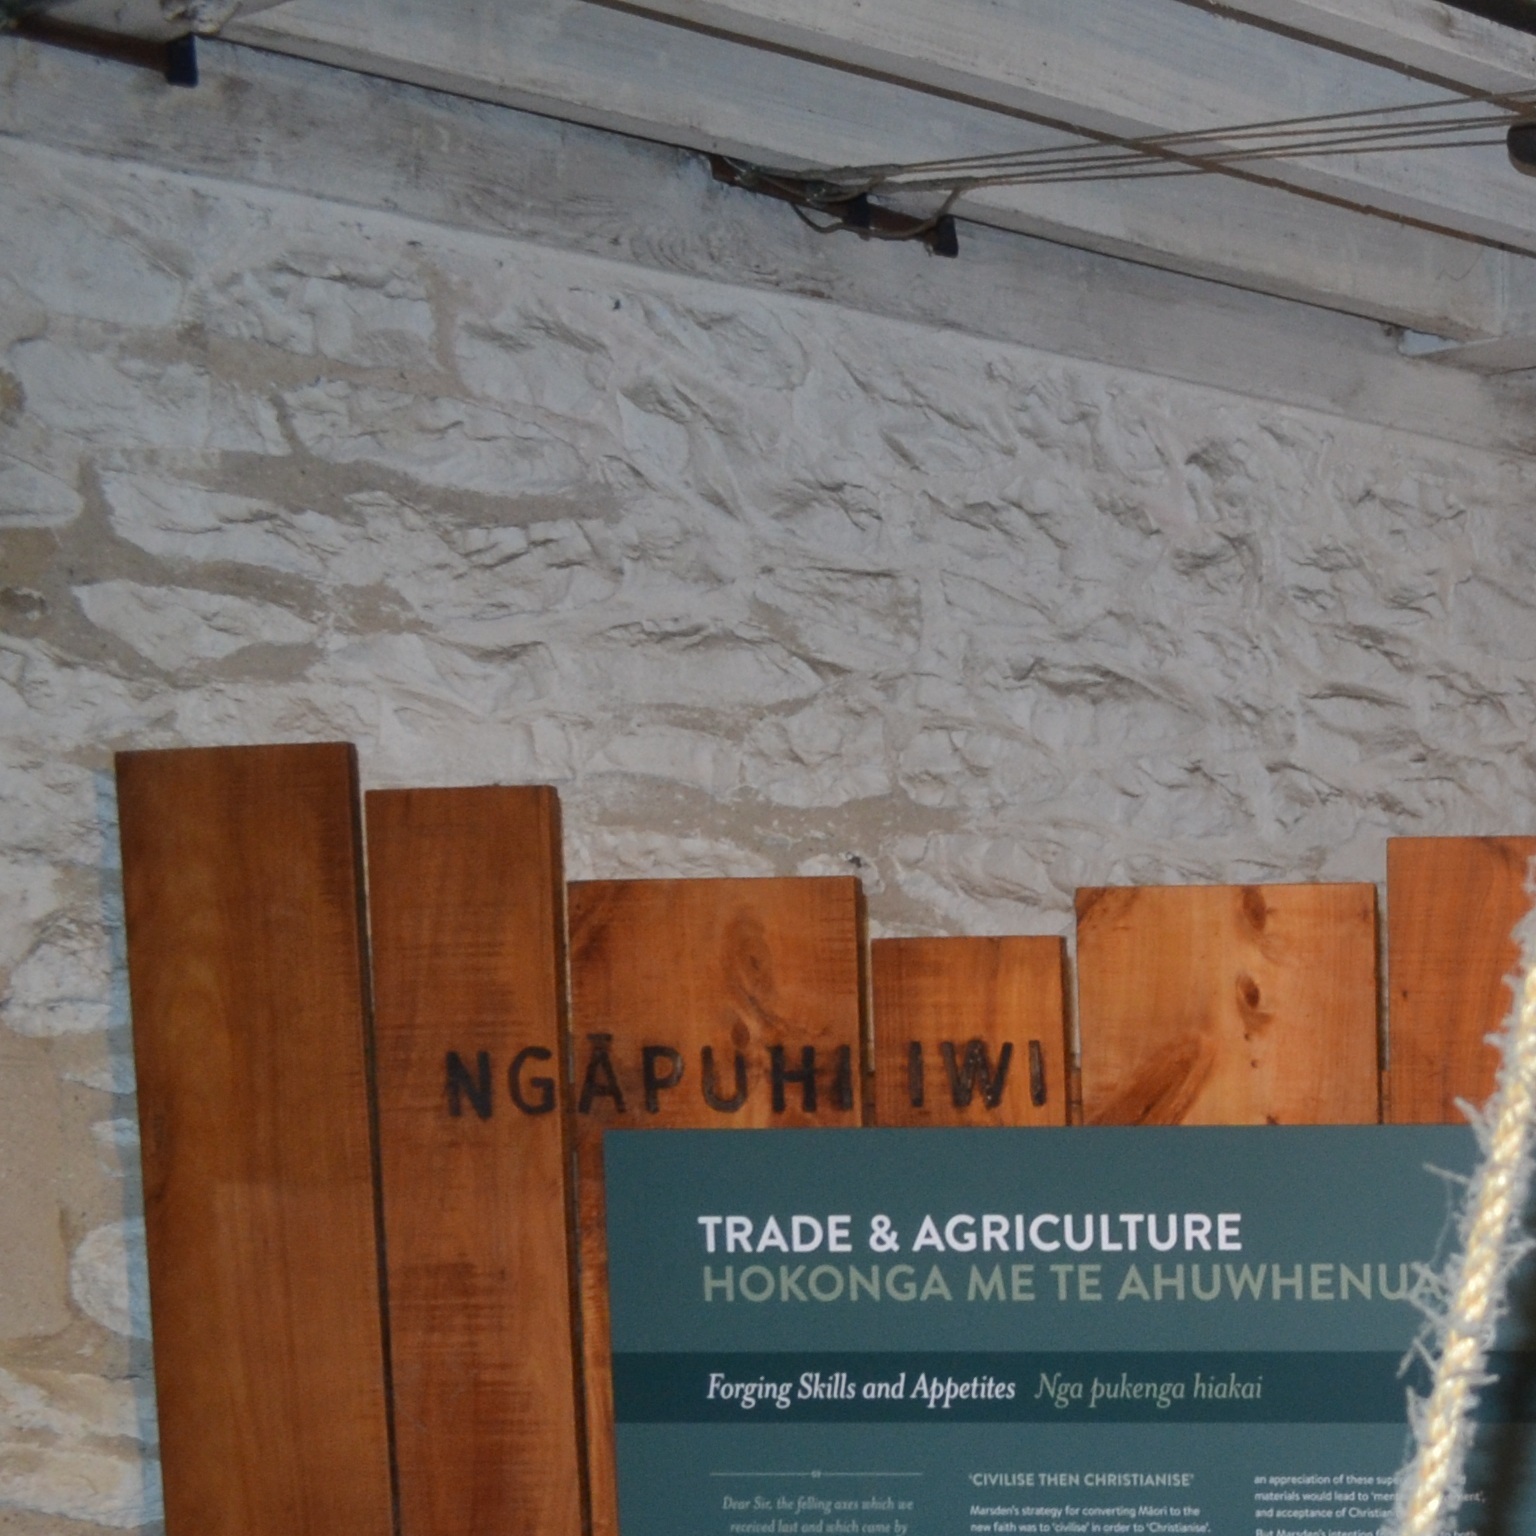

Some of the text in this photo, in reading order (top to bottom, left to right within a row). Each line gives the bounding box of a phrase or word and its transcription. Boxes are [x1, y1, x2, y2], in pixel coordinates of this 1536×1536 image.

[446, 1033, 1047, 1119] NGĀPUHI IWI
[698, 1214, 1241, 1252] TRADE & AGRICULTURE
[704, 1263, 1446, 1301] HOKONGA ME TE AHUWHENUA
[707, 1372, 1015, 1409] Forging Skills and Appetites
[1035, 1372, 1262, 1408] Nga pukenga hiakai
[1038, 1473, 1080, 1486] THEN
[1254, 1474, 1374, 1486] an appreciation of these
[1254, 1492, 1369, 1501] materials would lead to
[1021, 1507, 1063, 1518] strategy
[1065, 1505, 1080, 1516] for
[1082, 1507, 1136, 1518] converting
[1169, 1507, 1181, 1516] to
[1183, 1506, 1200, 1516] the
[1255, 1507, 1347, 1518] and acceptance of
